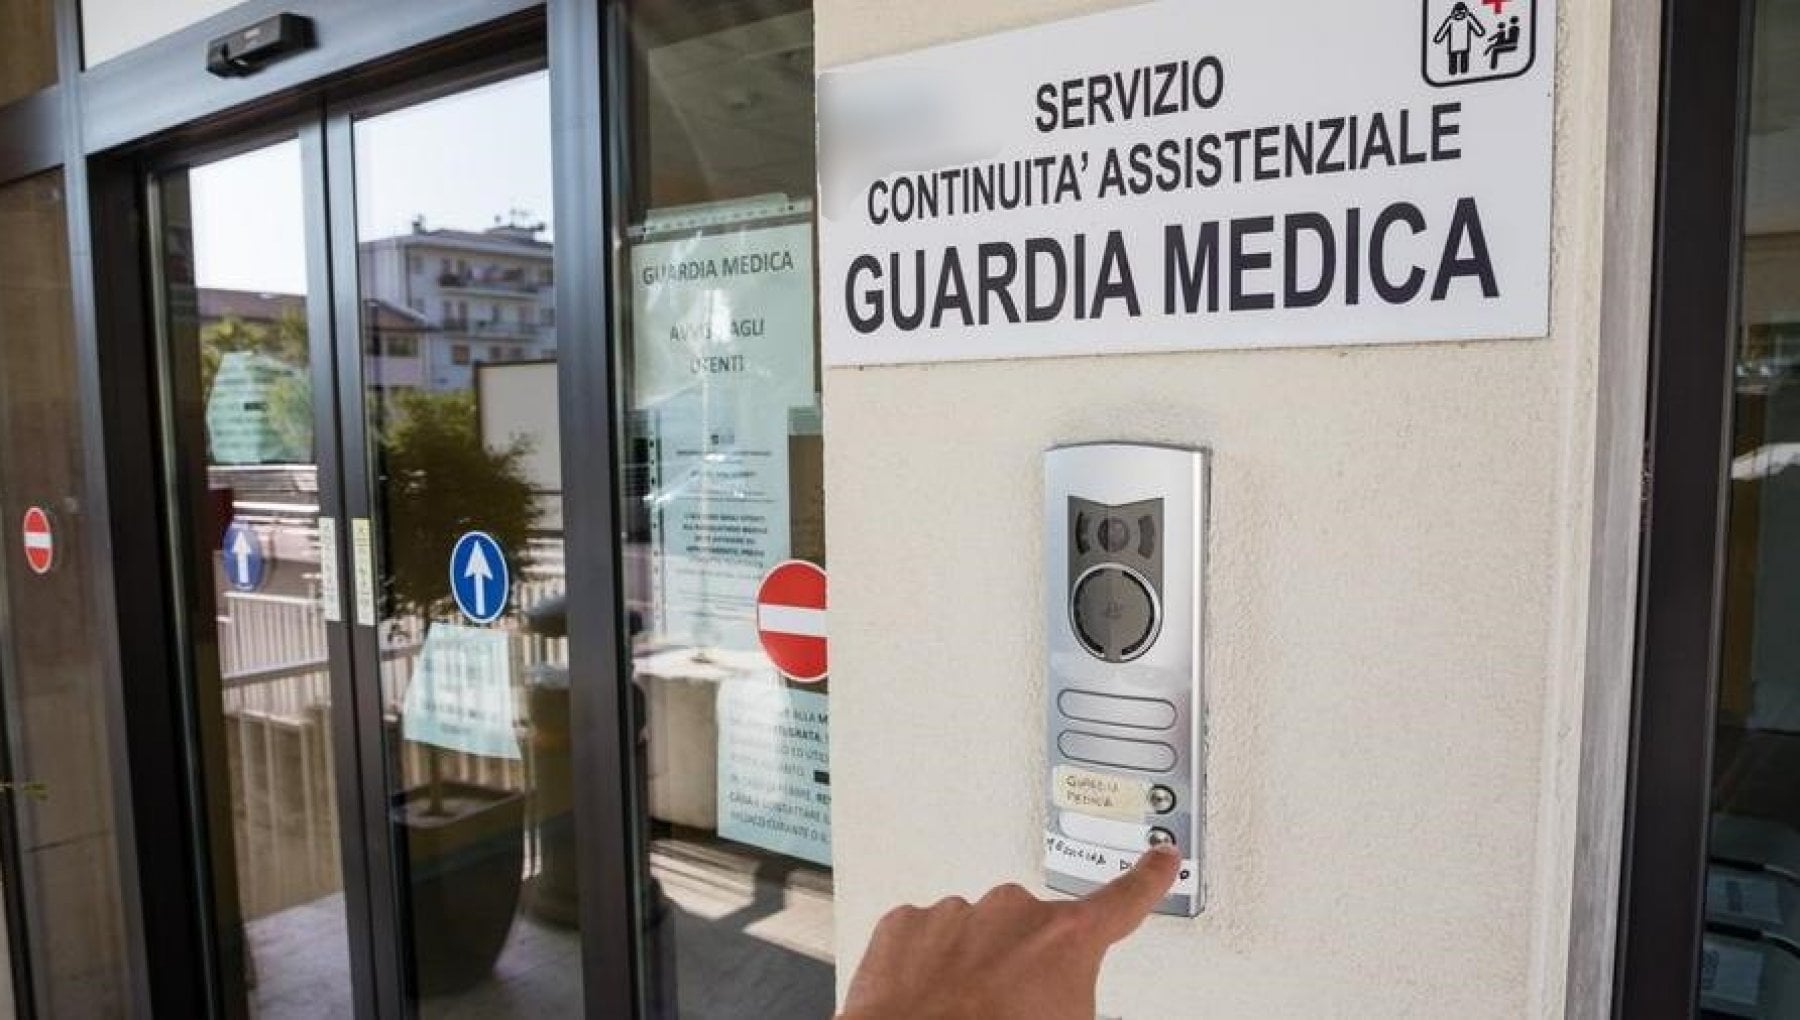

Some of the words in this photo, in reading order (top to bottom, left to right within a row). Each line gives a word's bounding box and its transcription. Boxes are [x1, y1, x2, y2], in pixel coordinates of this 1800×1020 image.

[1035, 55, 1225, 132] SERVIZIO
[1098, 102, 1463, 199] ASSISTENZIALE
[722, 250, 794, 277] MEDICA
[844, 229, 1141, 335] GUARDIA
[1164, 197, 1500, 316] MEDICA
